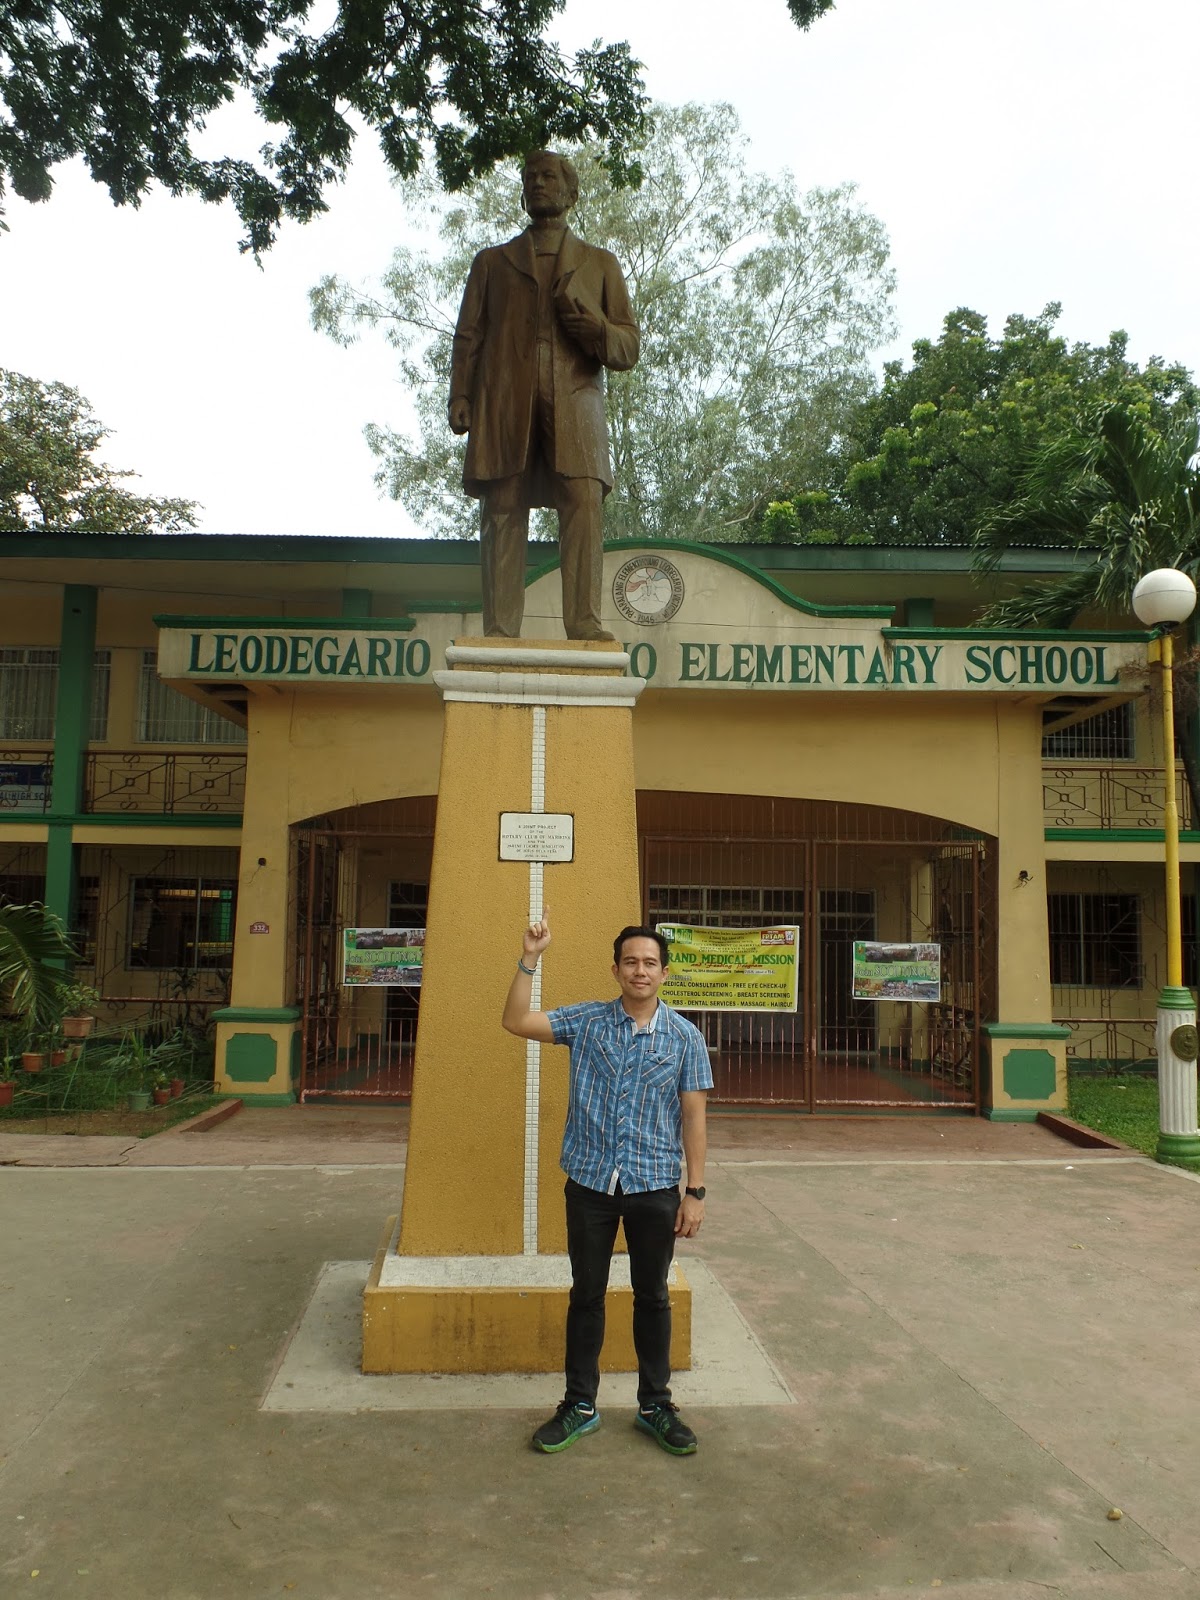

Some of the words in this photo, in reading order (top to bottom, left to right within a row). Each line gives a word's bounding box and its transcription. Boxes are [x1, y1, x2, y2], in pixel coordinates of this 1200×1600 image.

[187, 633, 431, 677] LEODEGARIO
[678, 641, 945, 684] ELEMENTARY
[964, 644, 1120, 685] SCHOOL
[668, 952, 697, 963] RAND
[702, 954, 748, 965] MEDICAL
[753, 954, 794, 965] MISSION
